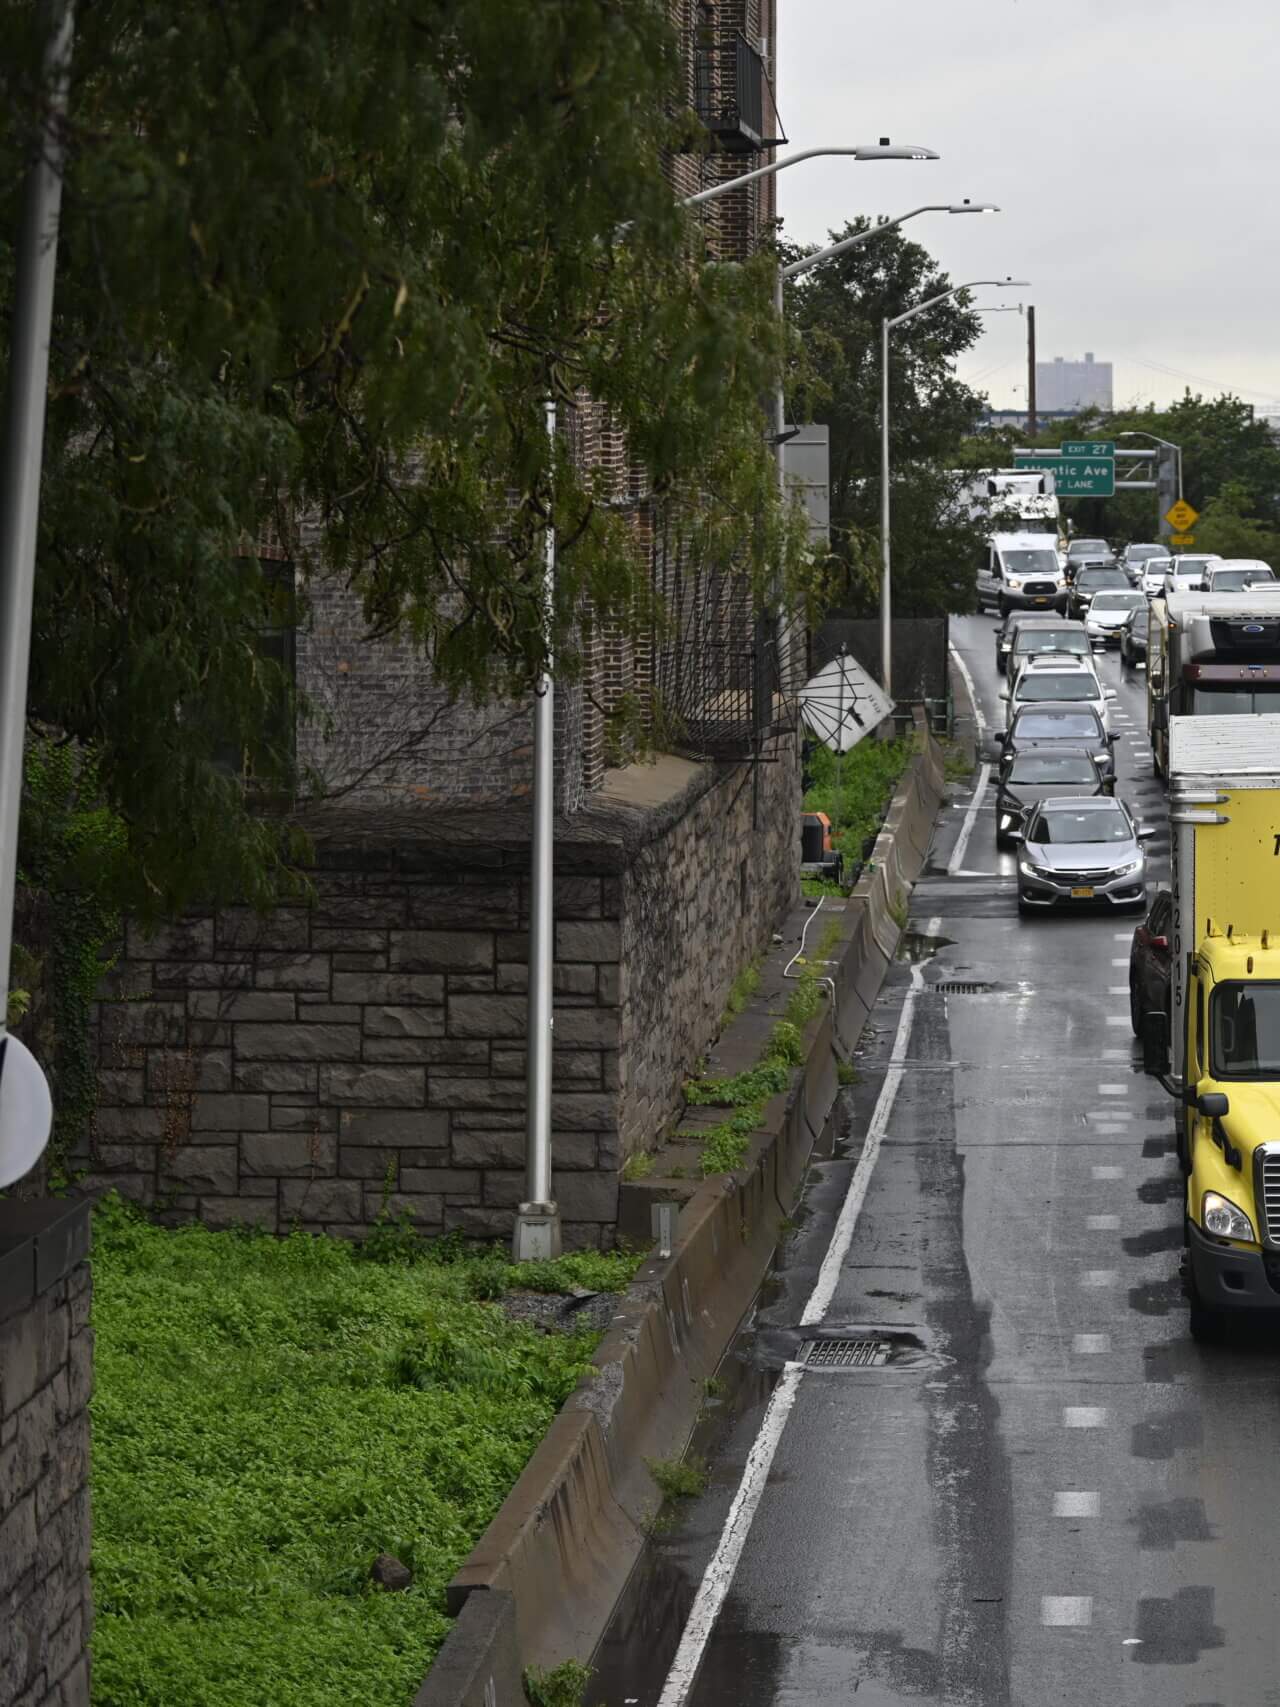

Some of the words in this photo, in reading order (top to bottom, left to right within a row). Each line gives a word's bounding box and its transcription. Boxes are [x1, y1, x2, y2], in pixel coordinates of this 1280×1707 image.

[1092, 444, 1107, 455] 27
[1083, 465, 1108, 476] Ave
[1067, 480, 1094, 489] LANE
